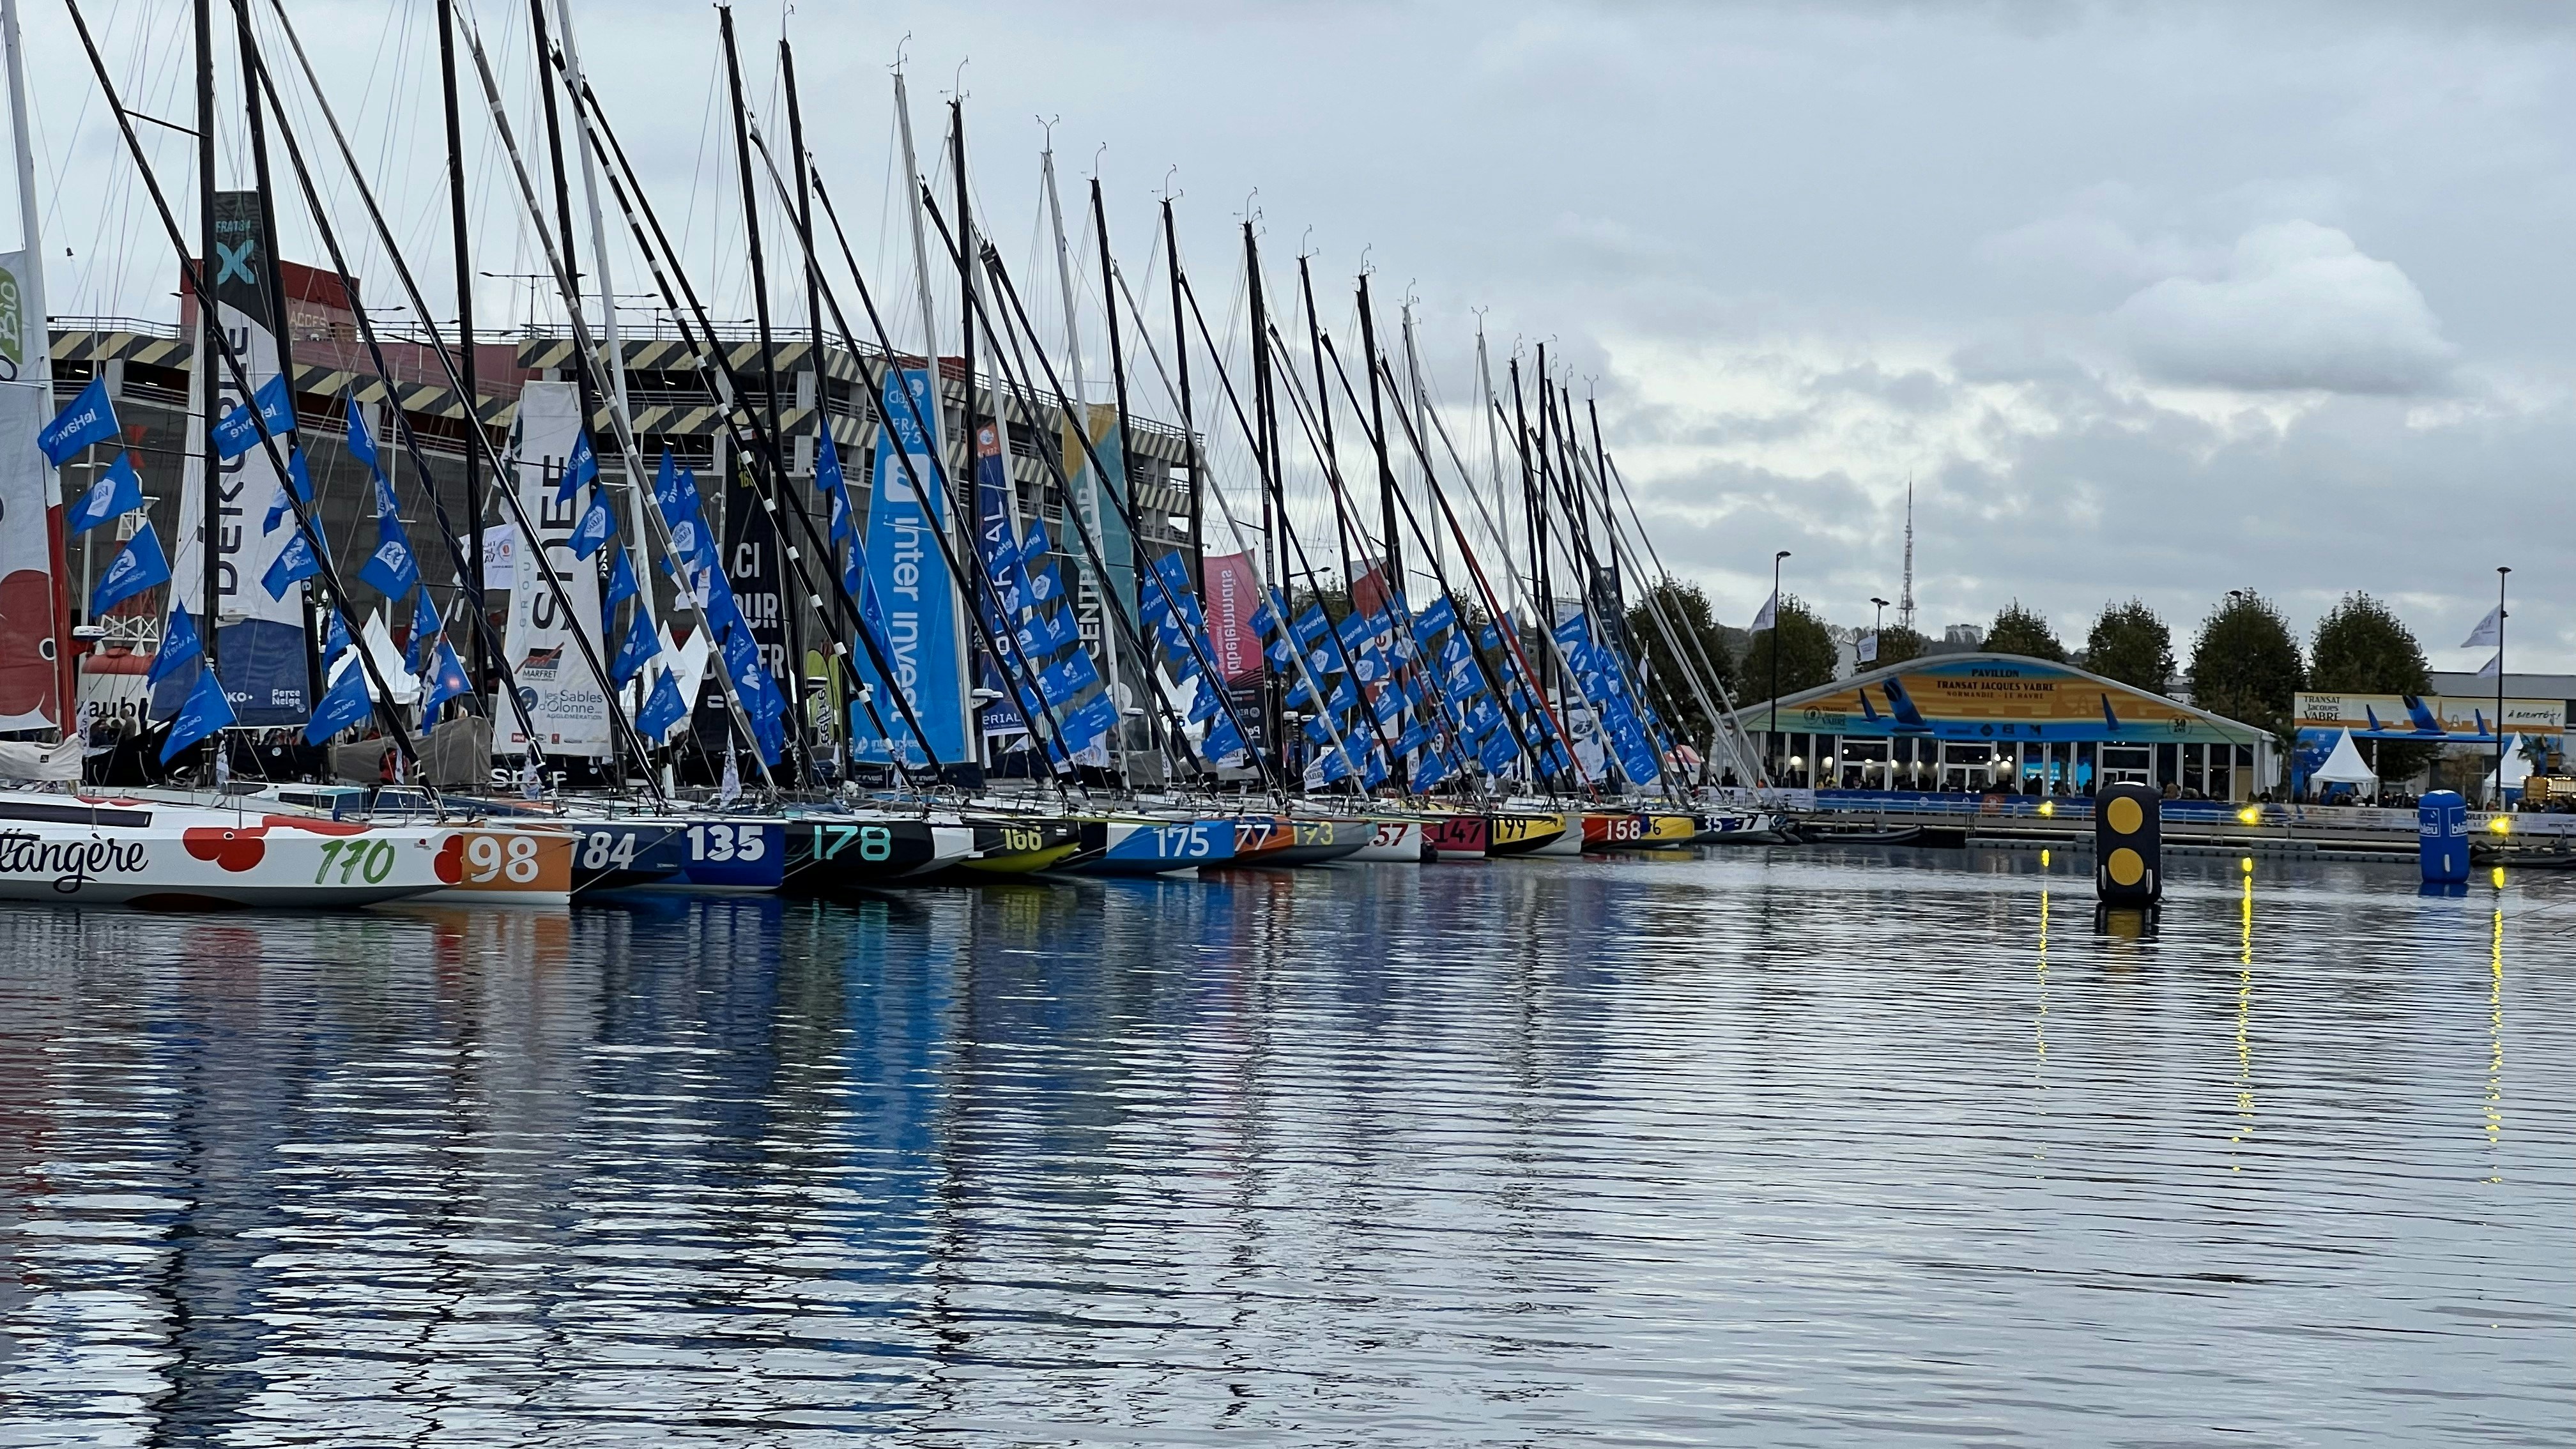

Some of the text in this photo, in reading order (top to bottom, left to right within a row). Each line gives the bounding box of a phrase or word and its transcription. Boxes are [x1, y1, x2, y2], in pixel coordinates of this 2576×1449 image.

[523, 670, 557, 678] MARFRET
[1972, 668, 2020, 678] PAVILLON
[1937, 680, 2055, 691] TRANSAT JACQUES VABRE
[272, 689, 300, 697] Perce
[544, 689, 603, 703] les Sables
[2303, 695, 2341, 703] TRANSAT
[539, 700, 594, 713] d'Olonne
[2303, 710, 2341, 721] VABRE
[1434, 820, 1481, 843] 147
[1607, 820, 1641, 840] 158
[687, 825, 765, 861] 135
[814, 825, 891, 861] 178
[1153, 827, 1209, 857] 175
[468, 836, 539, 883] 98
